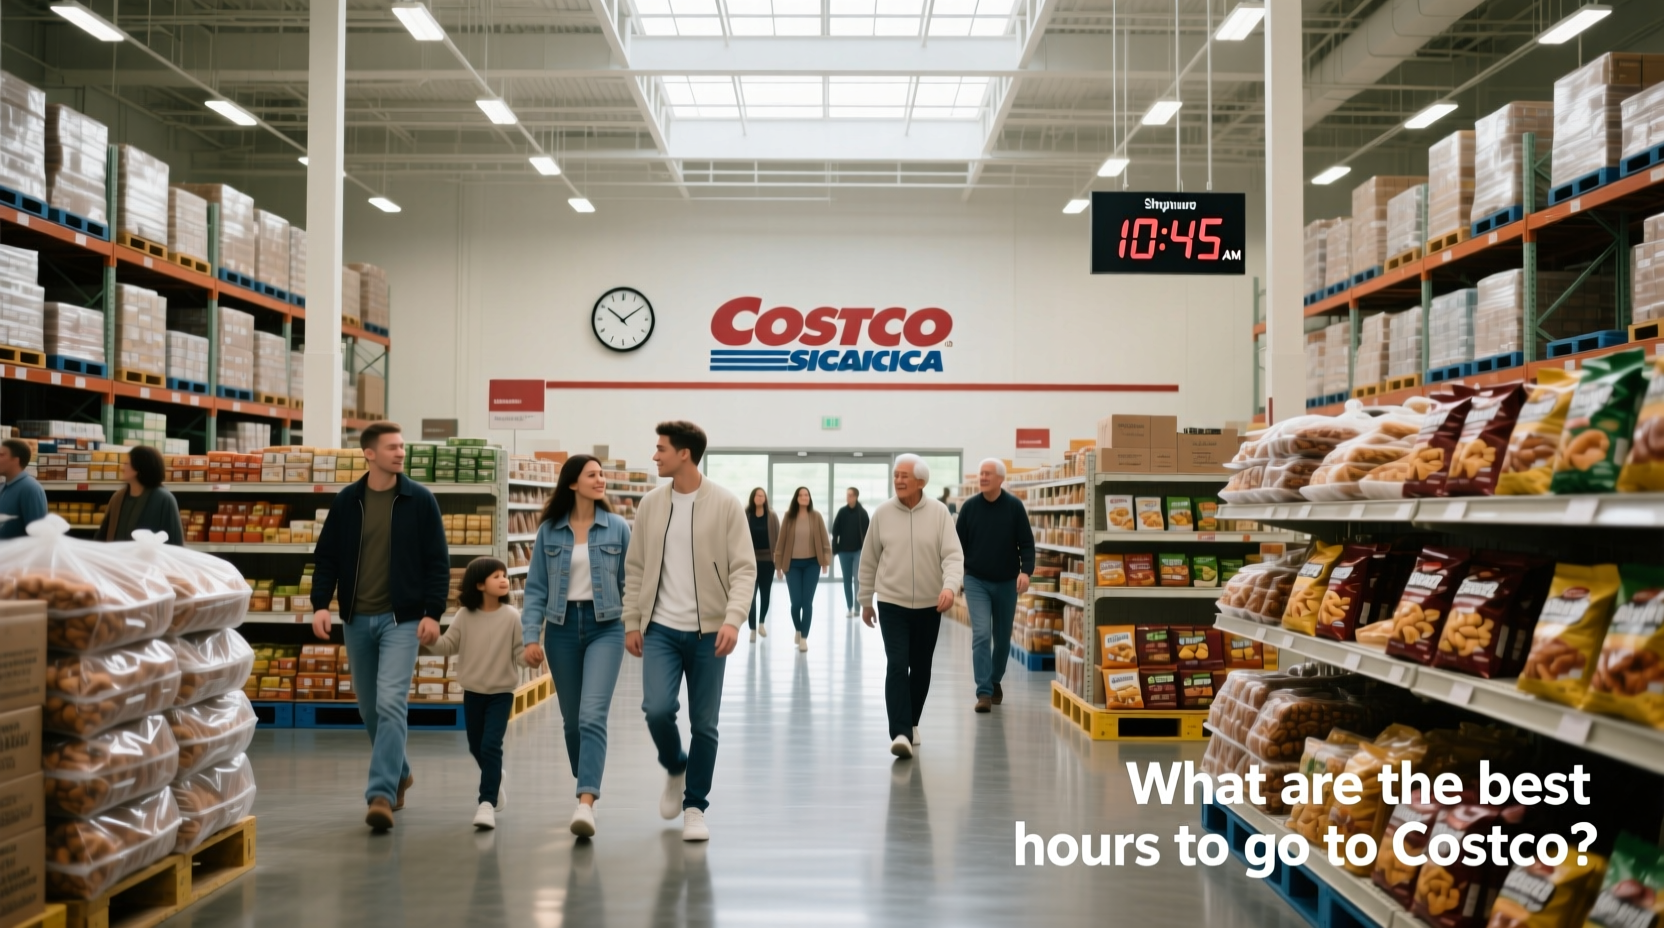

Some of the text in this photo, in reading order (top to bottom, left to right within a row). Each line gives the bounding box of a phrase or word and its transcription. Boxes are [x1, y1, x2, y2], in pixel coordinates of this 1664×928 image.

[1118, 217, 1242, 261] 10:45 AM
[710, 296, 953, 347] COSTCO
